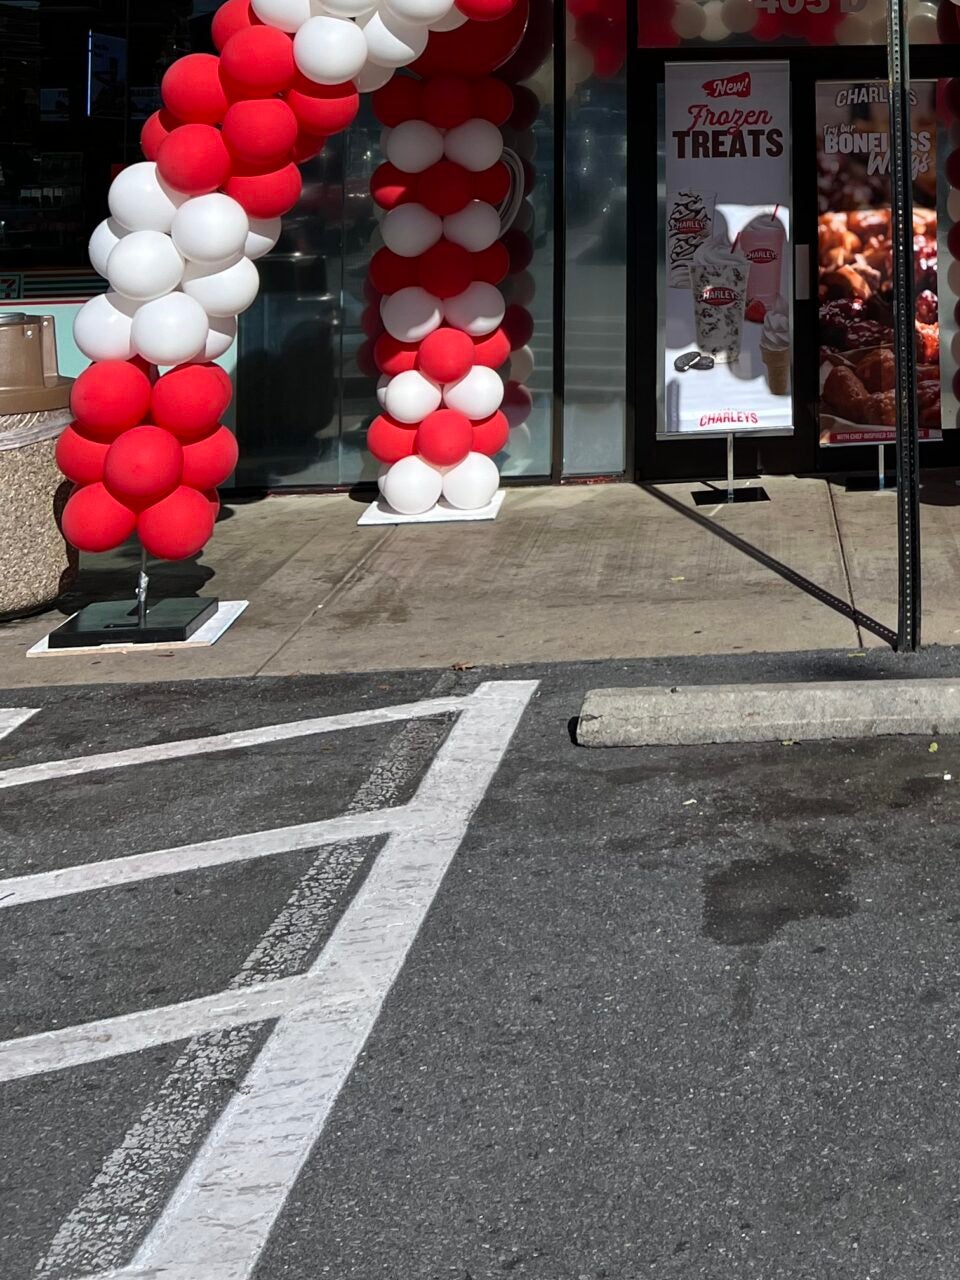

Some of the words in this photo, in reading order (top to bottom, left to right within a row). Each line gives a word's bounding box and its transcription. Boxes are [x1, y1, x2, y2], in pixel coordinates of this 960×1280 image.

[712, 78, 749, 96] New!
[836, 86, 918, 107] CHARLS
[688, 104, 773, 136] Frozen
[672, 128, 784, 160] TREATS
[824, 131, 932, 154] BONELSS
[699, 411, 758, 428] CHARLEYS
